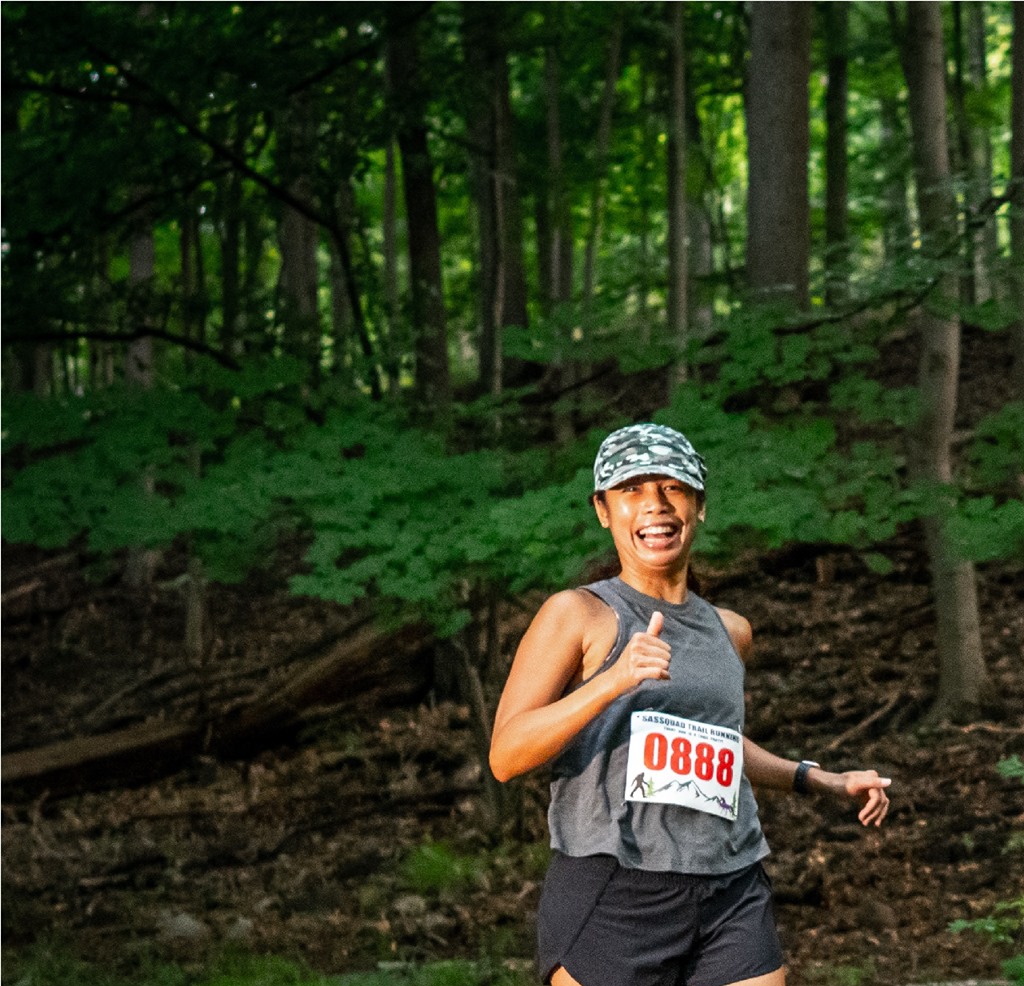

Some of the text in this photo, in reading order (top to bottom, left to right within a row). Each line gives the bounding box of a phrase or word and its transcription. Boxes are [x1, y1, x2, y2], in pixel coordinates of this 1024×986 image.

[642, 715, 686, 729] SASSQUAD
[688, 723, 708, 735] TRAIL
[710, 728, 740, 744] RUNNING
[643, 732, 734, 787] 0888
